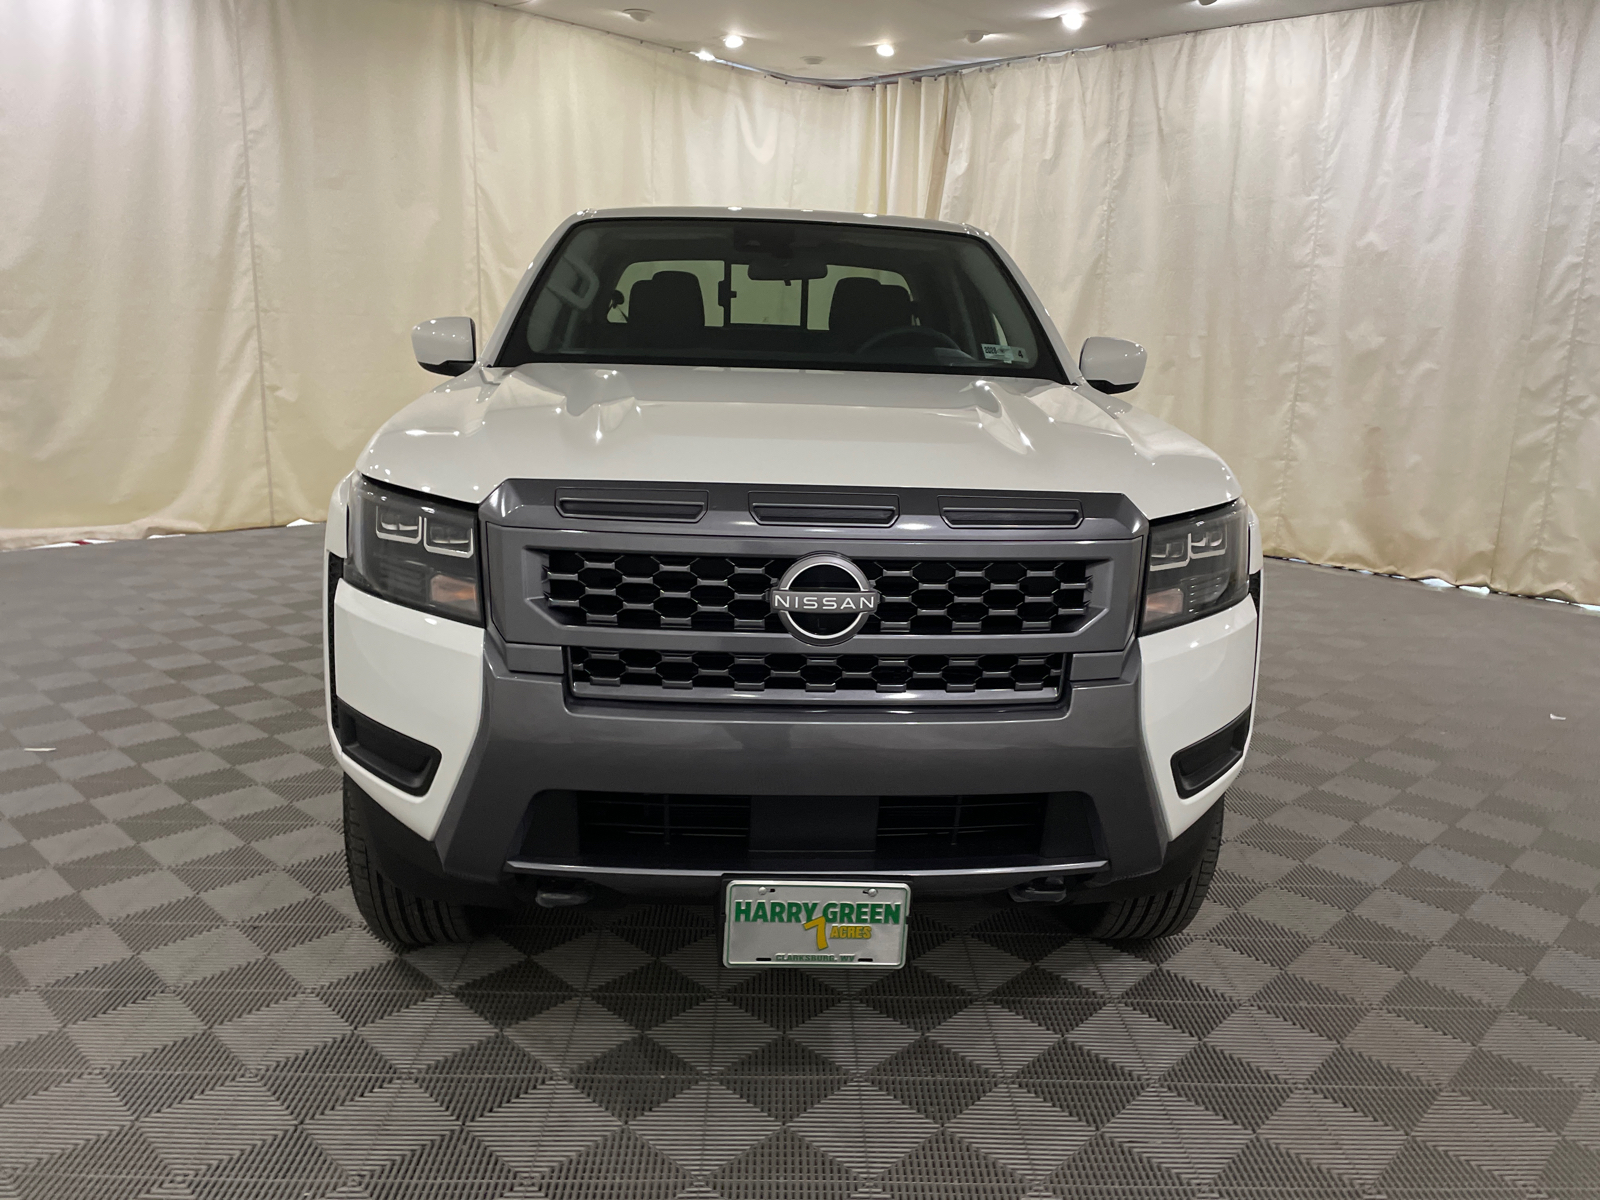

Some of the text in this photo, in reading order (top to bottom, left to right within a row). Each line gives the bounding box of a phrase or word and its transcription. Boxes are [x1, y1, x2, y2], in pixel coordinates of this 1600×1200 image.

[774, 594, 874, 609] NISSAN
[734, 900, 901, 924] HARRY GREEN
[803, 916, 872, 950] 7 ACRES
[839, 954, 855, 962] WV
